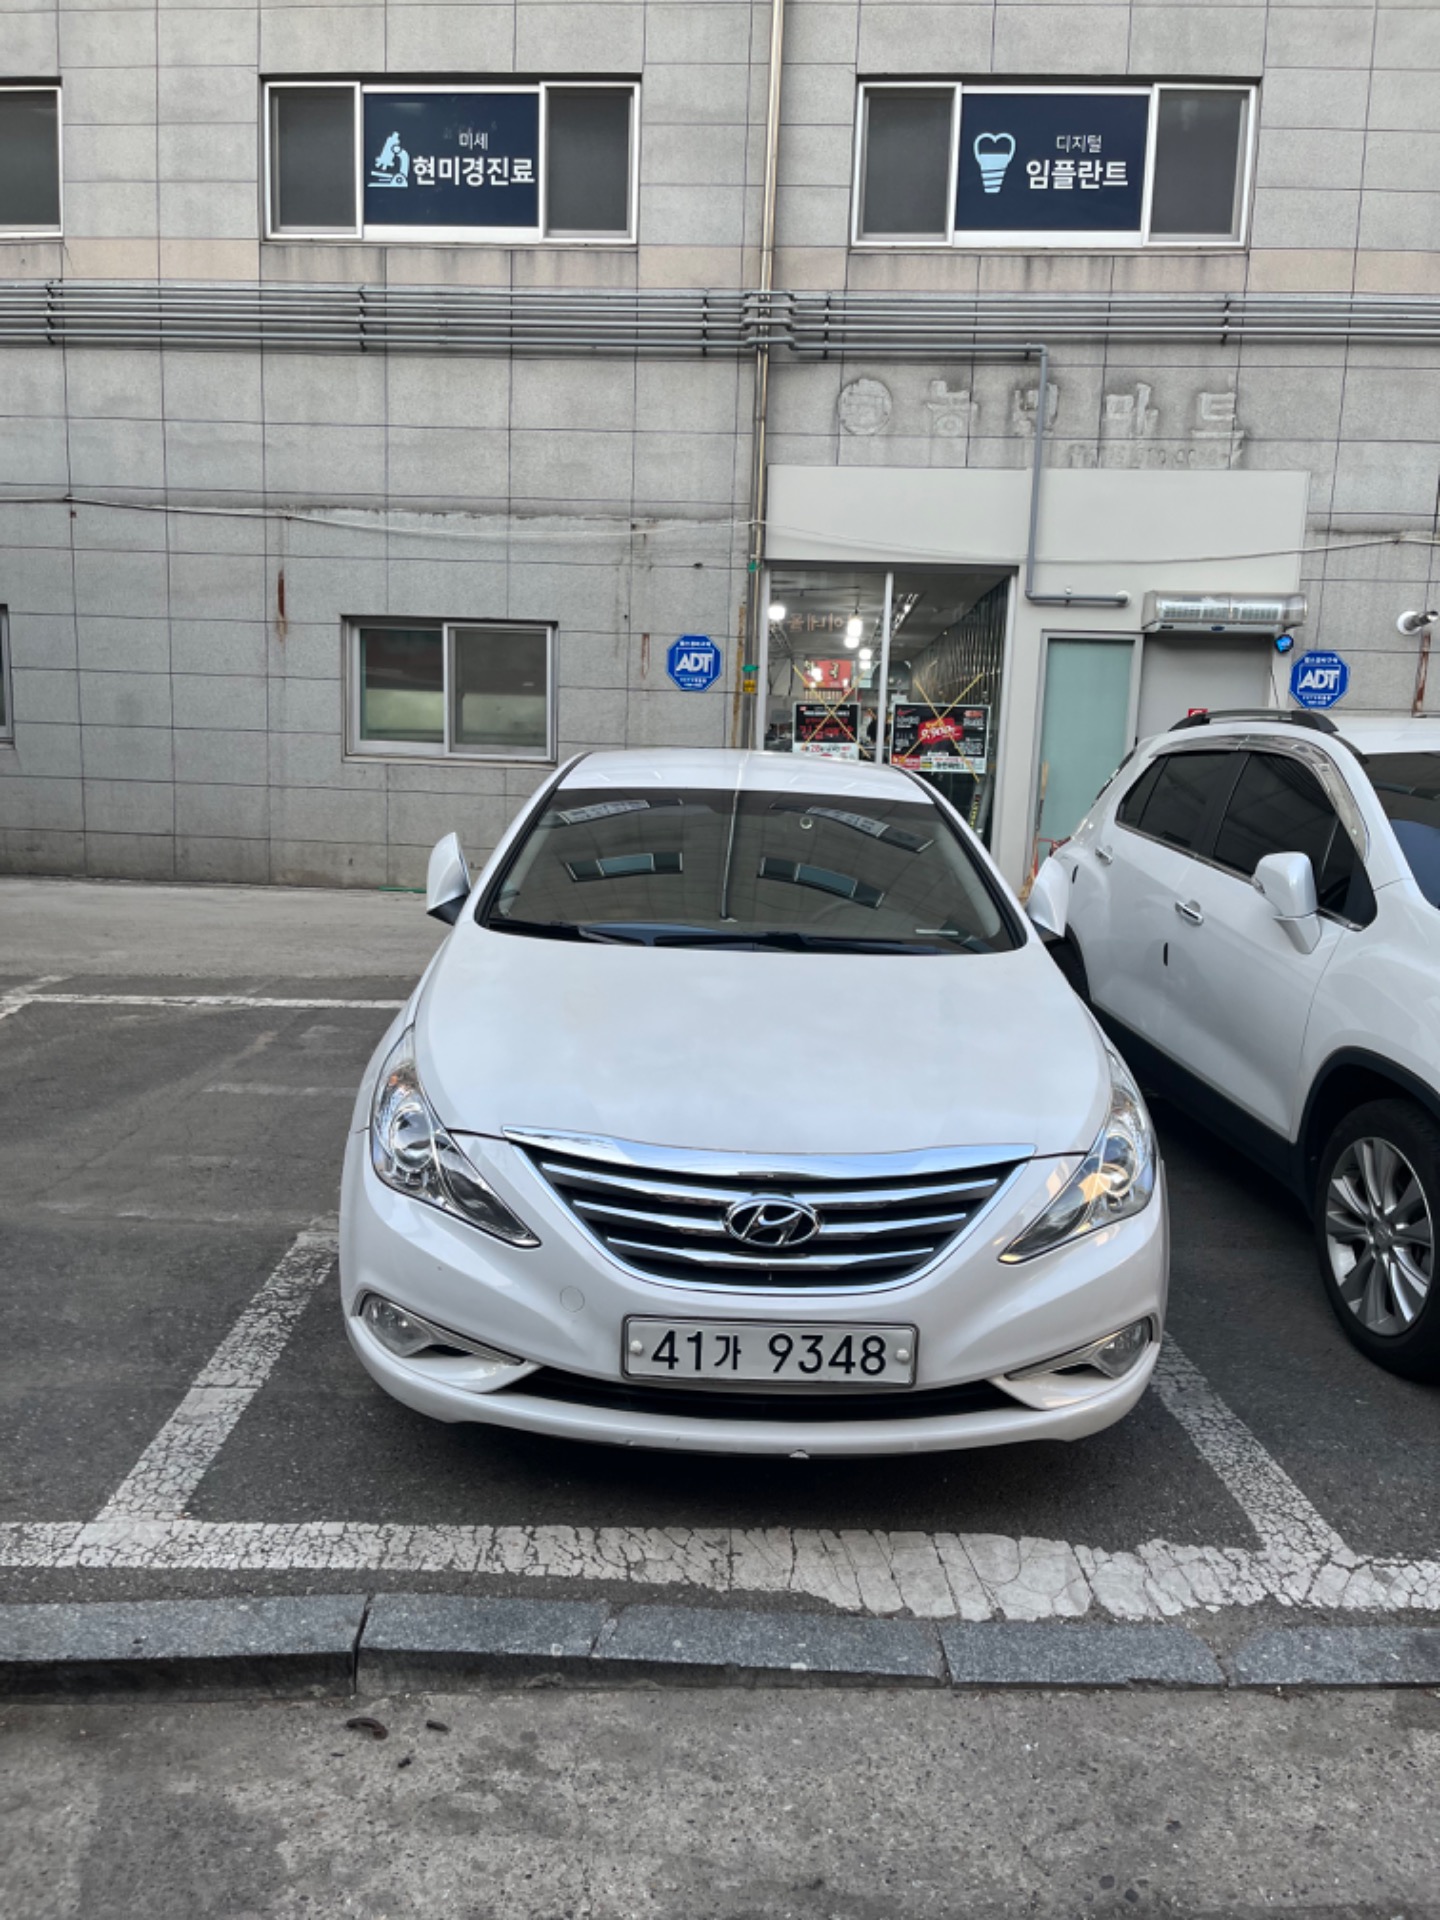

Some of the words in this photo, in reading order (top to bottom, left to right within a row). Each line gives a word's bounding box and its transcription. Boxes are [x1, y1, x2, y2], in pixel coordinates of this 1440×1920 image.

[458, 130, 488, 150] 미세
[1056, 134, 1102, 153] 디지털
[413, 156, 535, 187] 현미경진료
[1026, 159, 1128, 189] 임플란트
[675, 652, 713, 673] ADT
[1299, 669, 1340, 690] ADT
[651, 1330, 742, 1371] 41가
[767, 1333, 886, 1375] 9348
